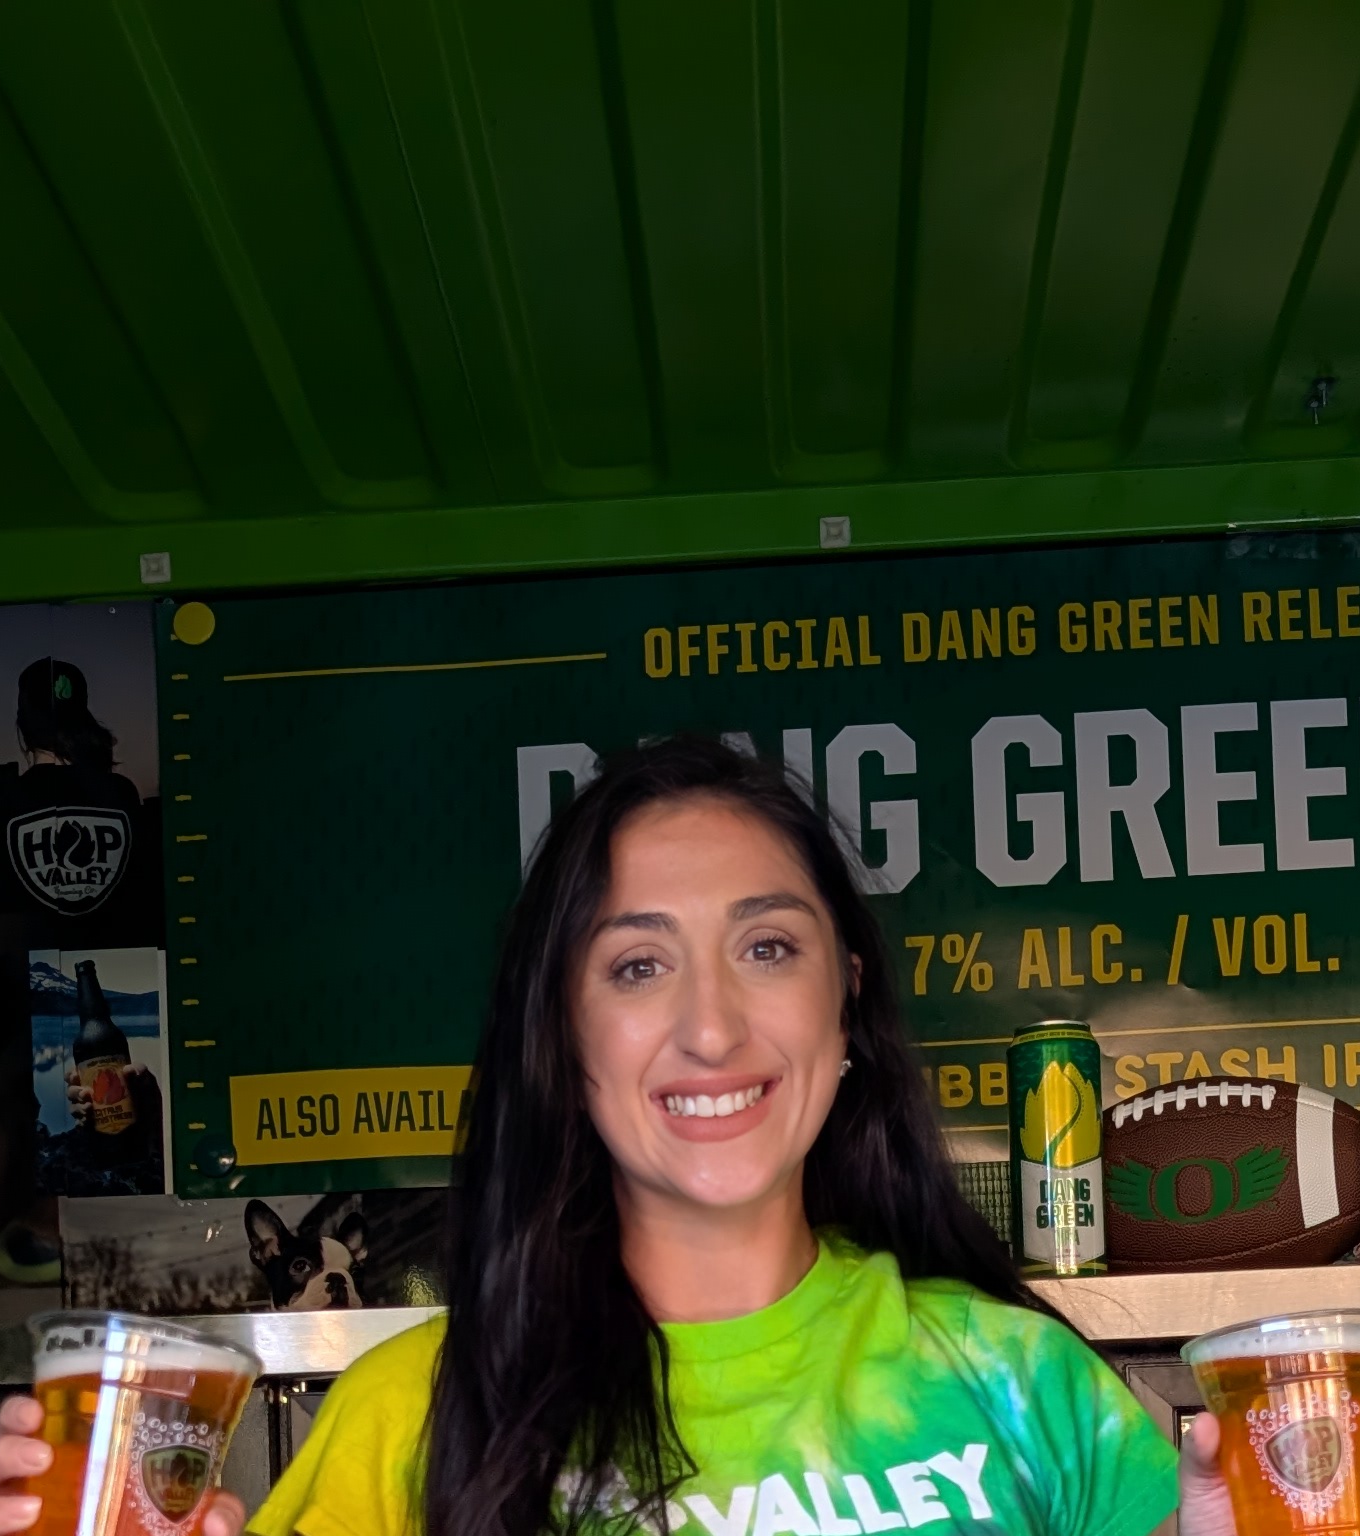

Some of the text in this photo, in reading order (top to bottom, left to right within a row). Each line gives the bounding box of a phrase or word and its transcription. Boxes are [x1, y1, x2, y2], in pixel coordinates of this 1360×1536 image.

[643, 615, 880, 679] OFFICIAL
[902, 604, 1036, 662] DANG
[1059, 593, 1220, 655] GREEN
[517, 724, 920, 894] DG
[23, 820, 122, 869] HOP
[36, 866, 111, 886] VALLEY
[904, 932, 994, 996] 7%
[1017, 924, 1143, 989] ALC.
[1212, 912, 1340, 978] VOL.
[256, 1093, 340, 1140] ALSO
